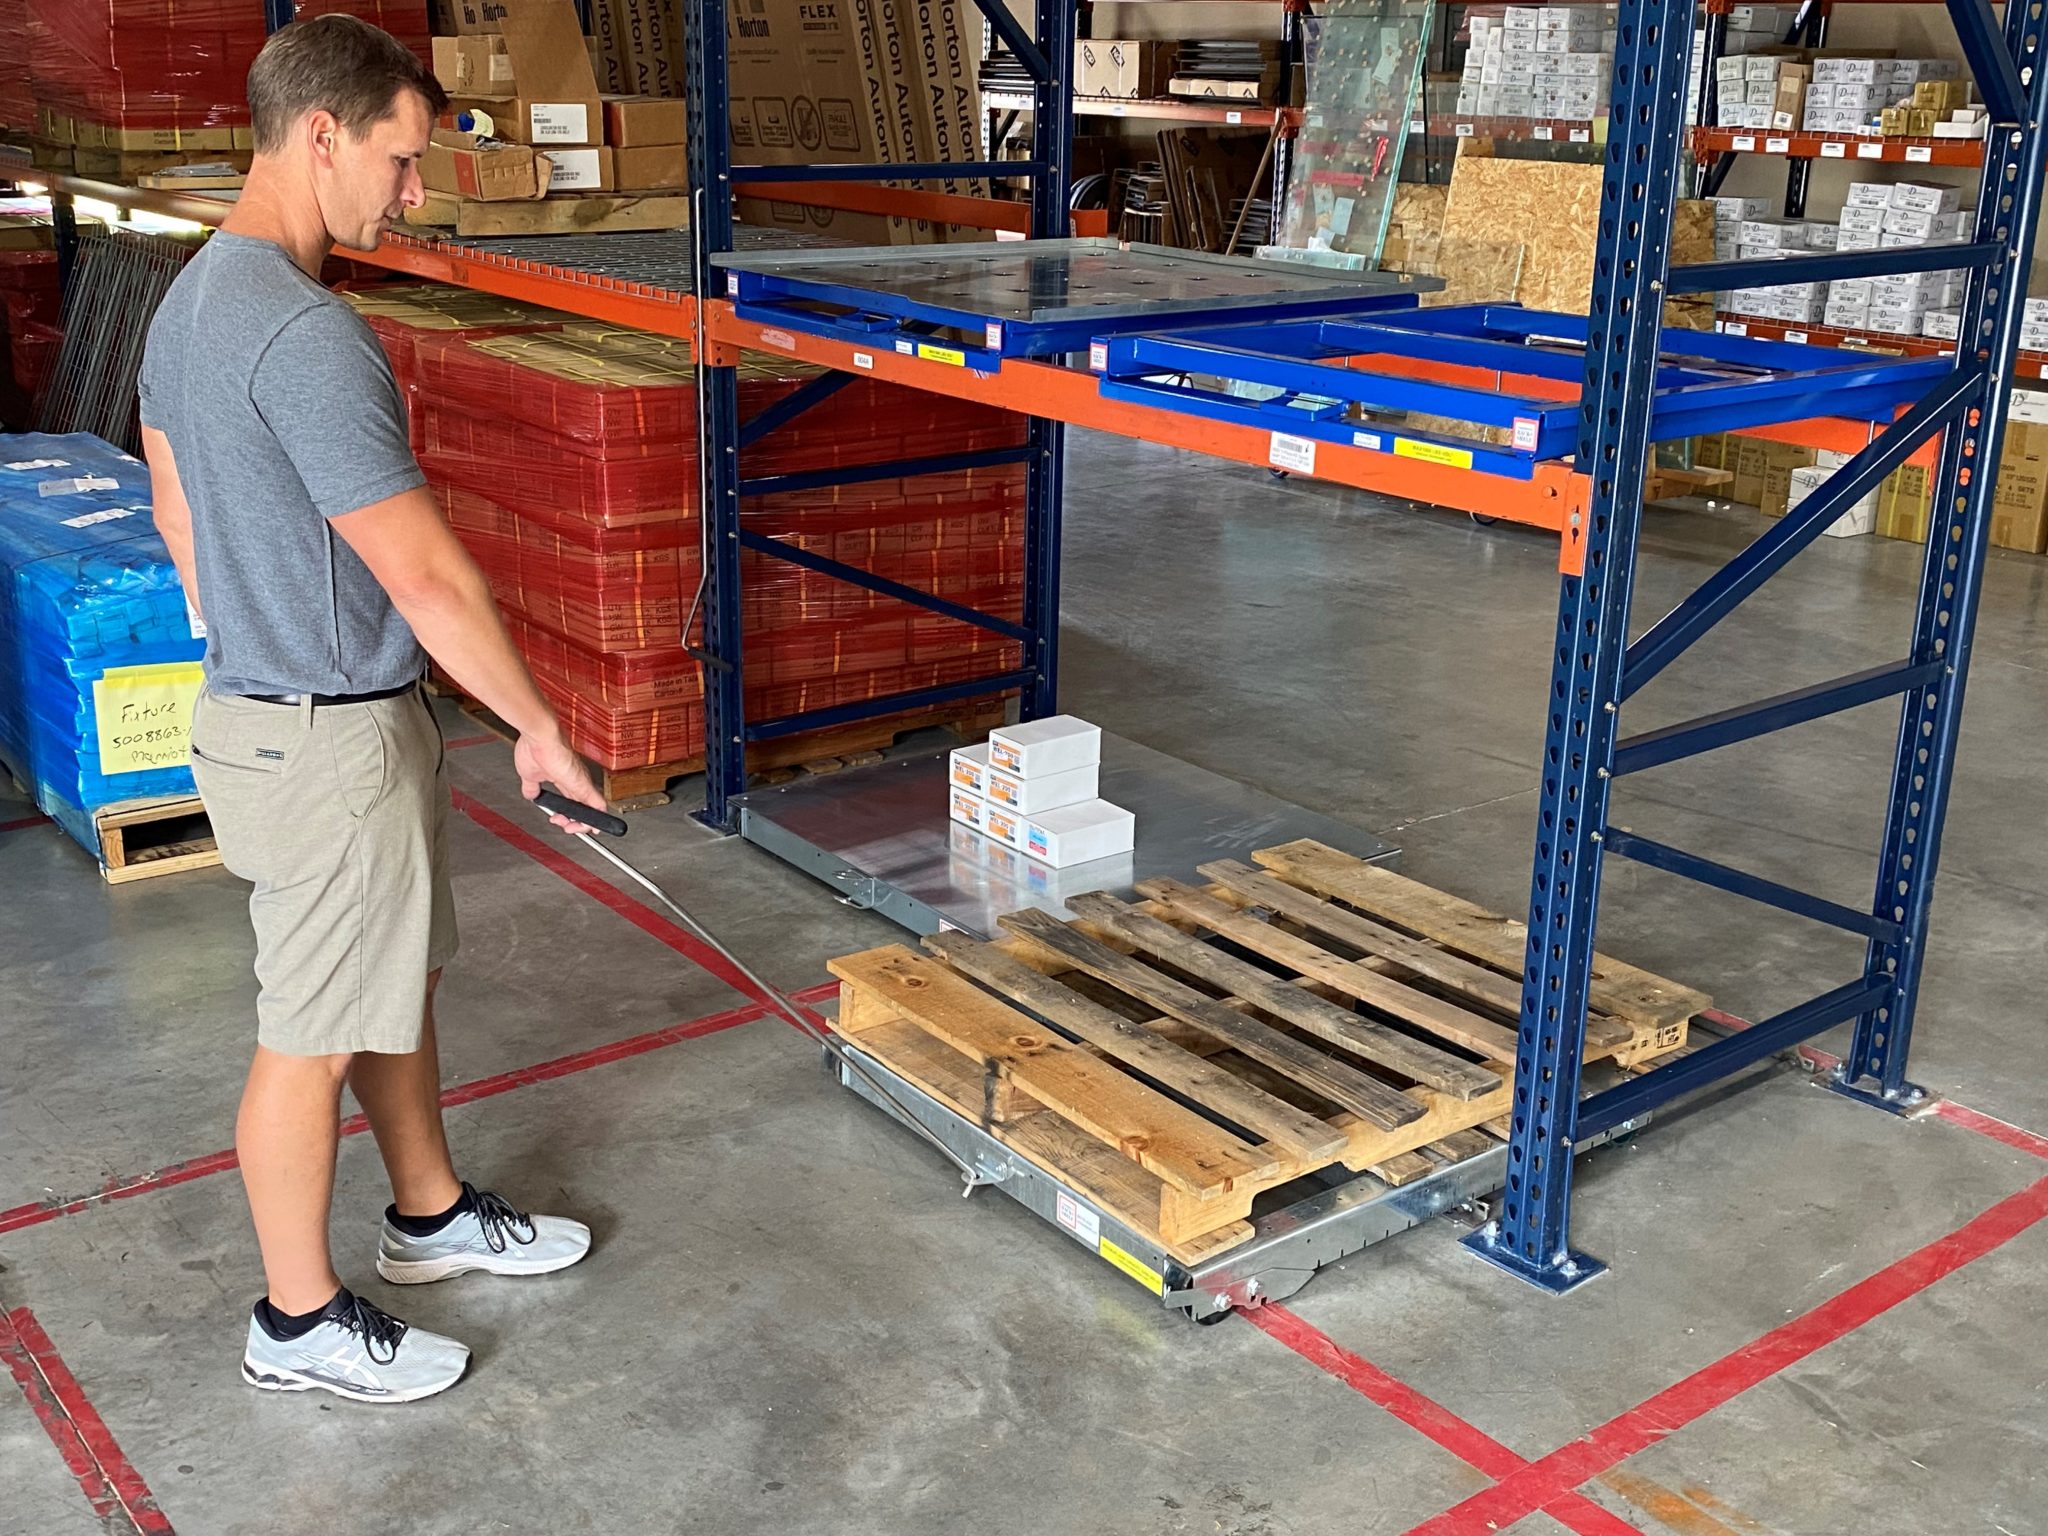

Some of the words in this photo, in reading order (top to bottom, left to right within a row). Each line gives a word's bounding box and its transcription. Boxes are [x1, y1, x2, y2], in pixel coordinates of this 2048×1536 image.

[799, 4, 837, 19] FLEX
[598, 0, 613, 51] rton
[736, 15, 770, 38] Horton
[881, 0, 902, 76] orton
[654, 680, 674, 689] Made
[121, 700, 177, 723] Fixture
